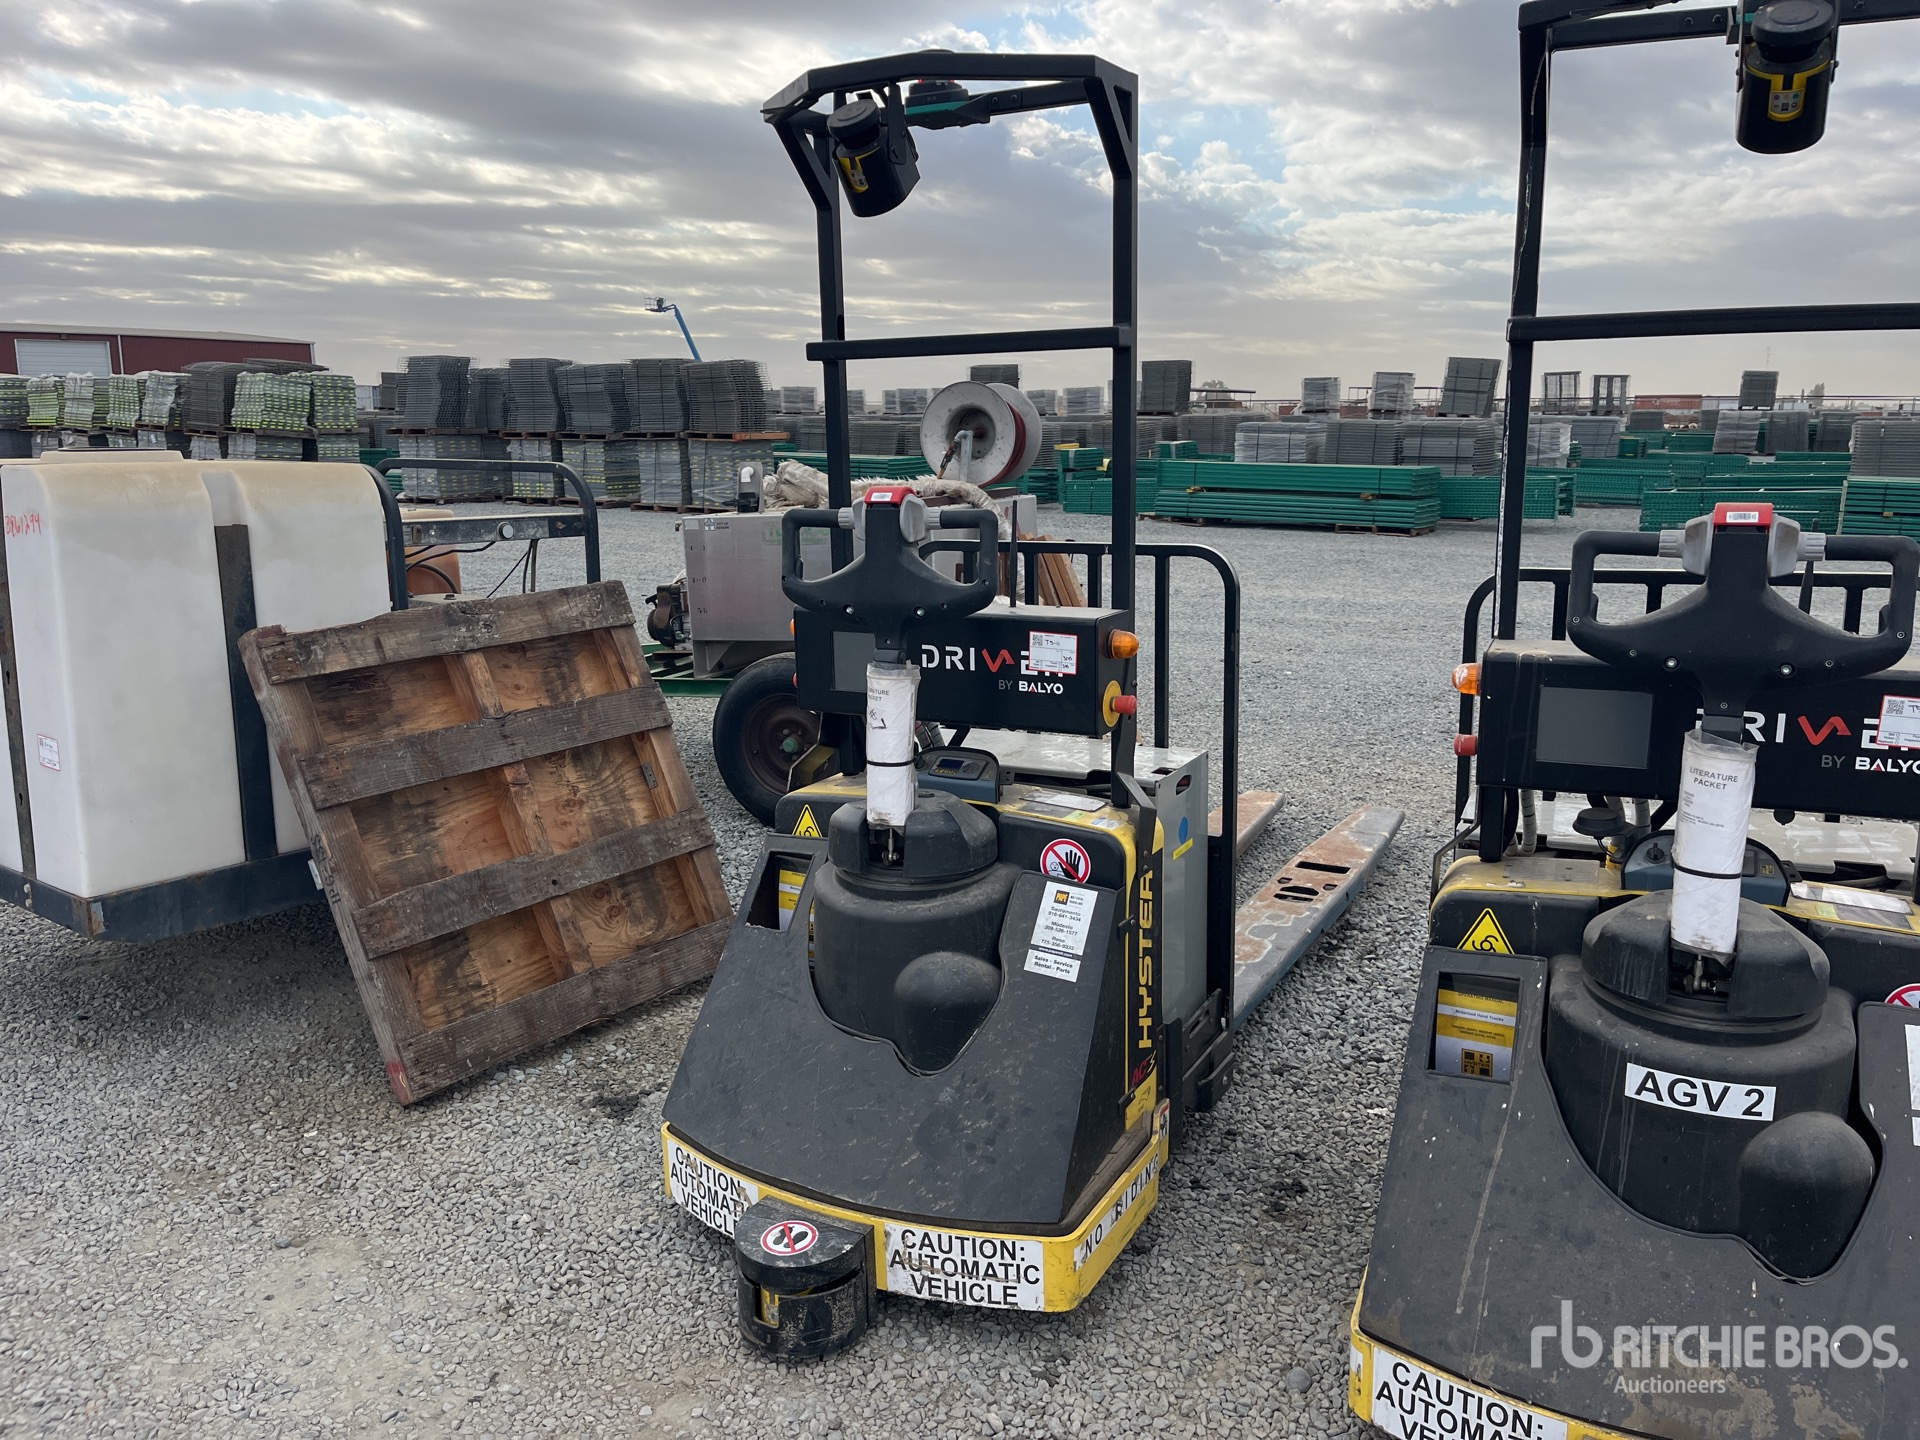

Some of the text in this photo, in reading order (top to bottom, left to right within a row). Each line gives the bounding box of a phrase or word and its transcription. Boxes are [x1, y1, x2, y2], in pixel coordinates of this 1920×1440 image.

[999, 680, 1064, 694] BY BALYO
[1821, 755, 1845, 768] BY
[1690, 767, 1738, 782] LITERATURE
[1694, 777, 1727, 790] PACKET
[1050, 906, 1082, 916] Sacramento
[1051, 922, 1073, 930] Modesto
[1054, 960, 1073, 968] Service
[1139, 869, 1153, 1048] HYSTER
[1634, 1071, 1764, 1116] AGV 2
[901, 1229, 1025, 1262] CAUTION:
[1086, 1224, 1102, 1255] NO
[890, 1249, 1040, 1284] AUTOMATIC
[910, 1274, 1018, 1306] VEHICLE
[1392, 1362, 1544, 1440] CAUTION:
